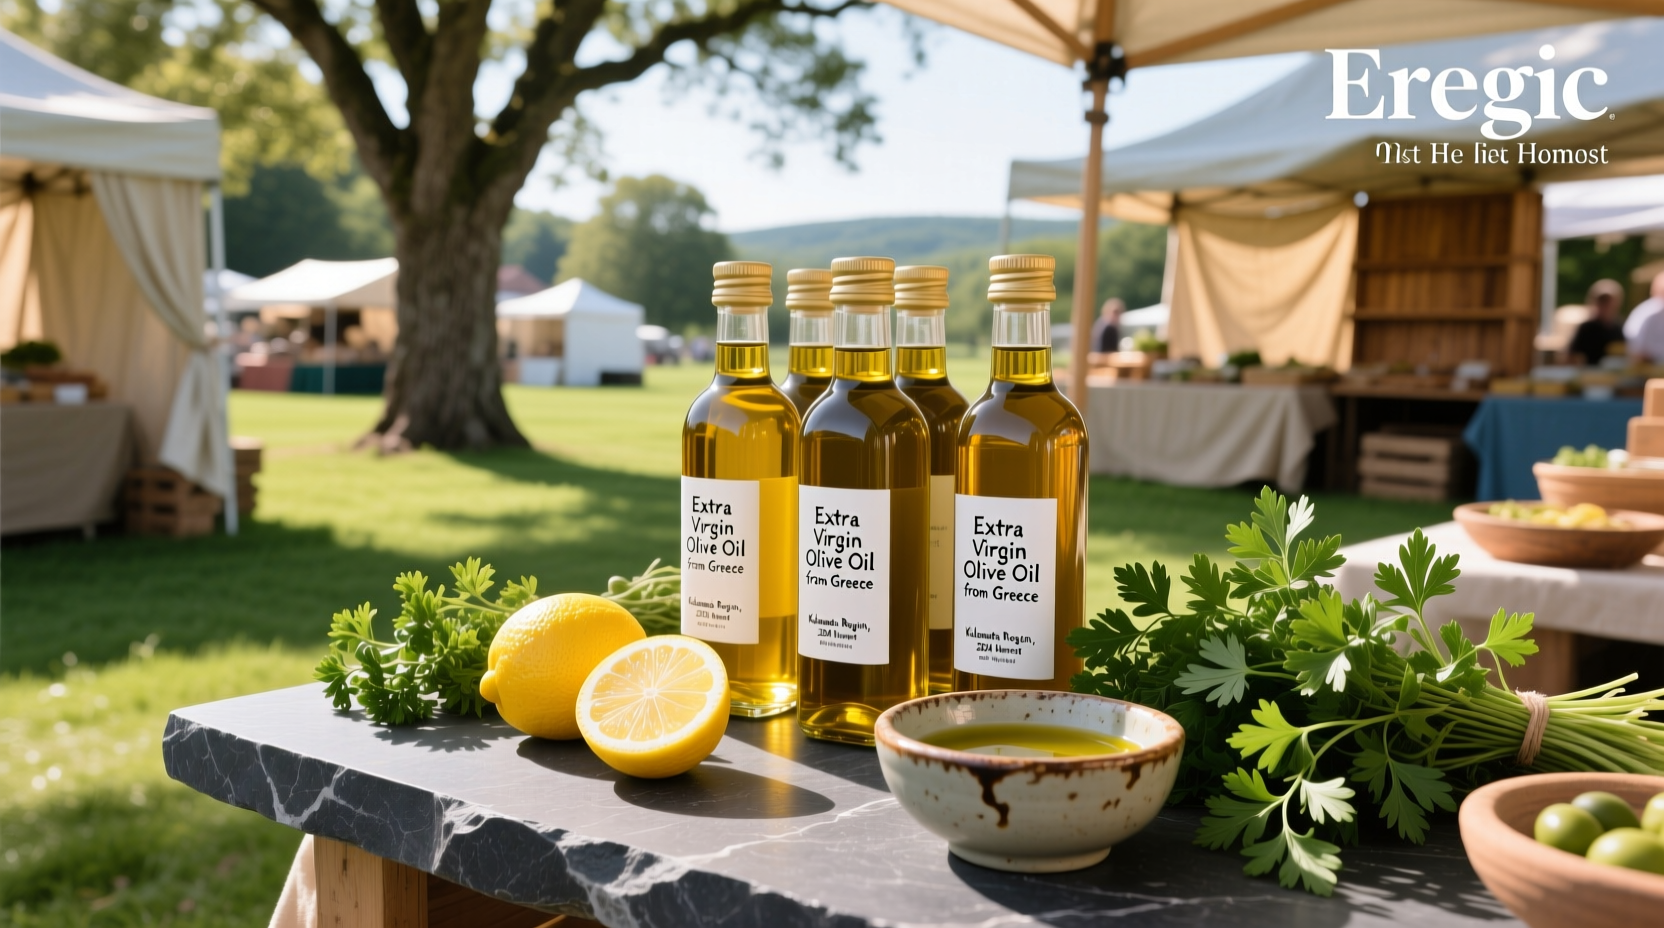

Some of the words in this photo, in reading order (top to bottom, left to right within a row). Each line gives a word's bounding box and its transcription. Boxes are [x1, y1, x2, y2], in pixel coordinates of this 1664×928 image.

[693, 496, 732, 515] Extra
[816, 506, 859, 527] Extra
[974, 516, 1023, 538] Extra
[692, 516, 733, 540] Virgin
[687, 537, 717, 555] Olive
[723, 539, 745, 556] Oil
[814, 528, 861, 553] Virgin
[806, 549, 842, 569] Olive
[848, 552, 874, 570] Oil
[973, 539, 1026, 565] Virgin
[709, 560, 744, 574] Greece
[964, 560, 1006, 580] Olive
[1012, 564, 1039, 582] Oil
[831, 574, 873, 589] Greece
[964, 582, 988, 597] from
[993, 586, 1038, 602] Greece
